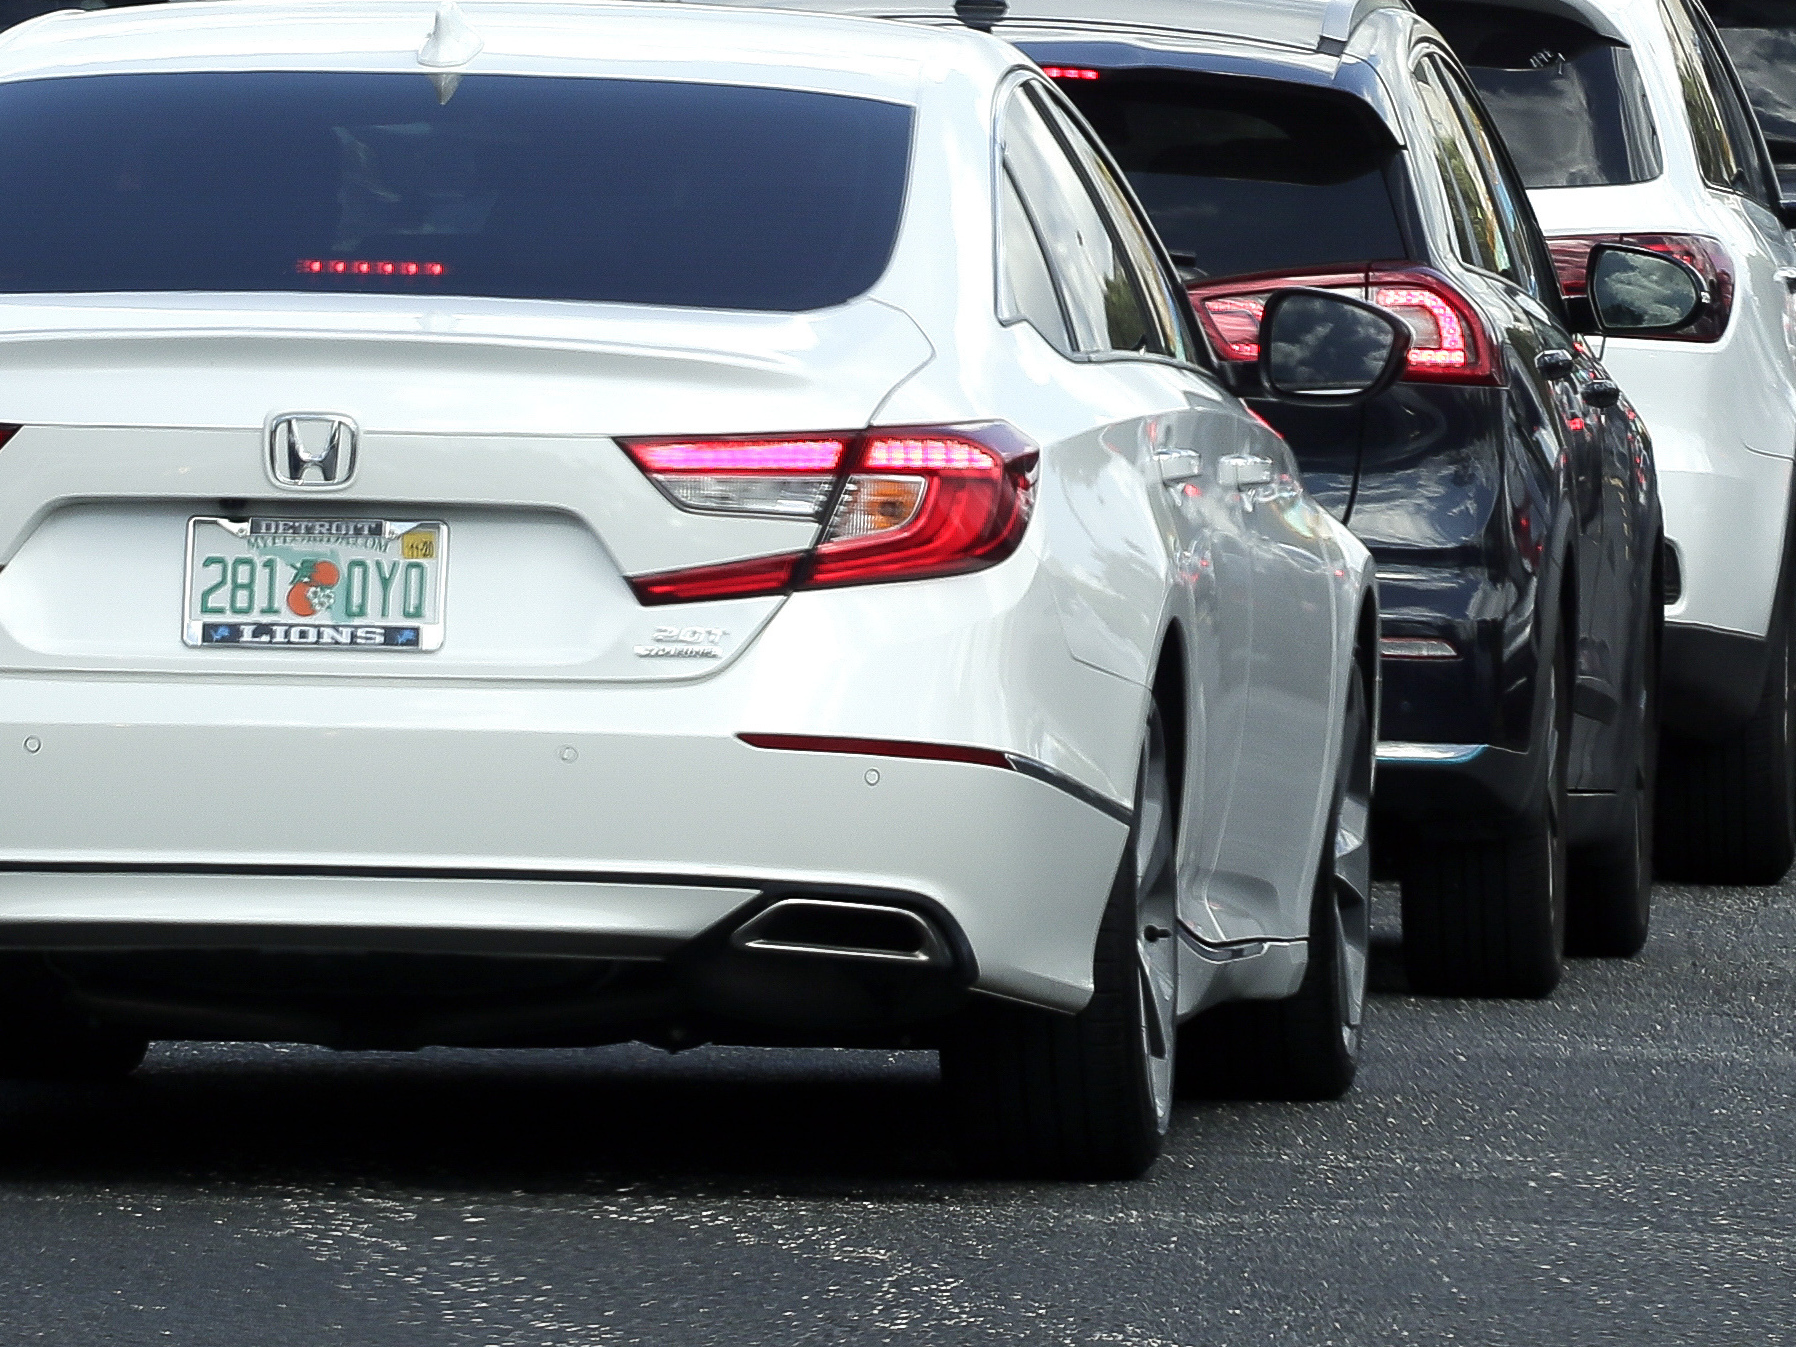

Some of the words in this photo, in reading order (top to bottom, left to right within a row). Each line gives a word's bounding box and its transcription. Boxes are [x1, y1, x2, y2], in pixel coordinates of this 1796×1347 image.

[260, 520, 377, 535] DETROIT
[200, 556, 280, 614] 281
[238, 624, 386, 645] LIONS
